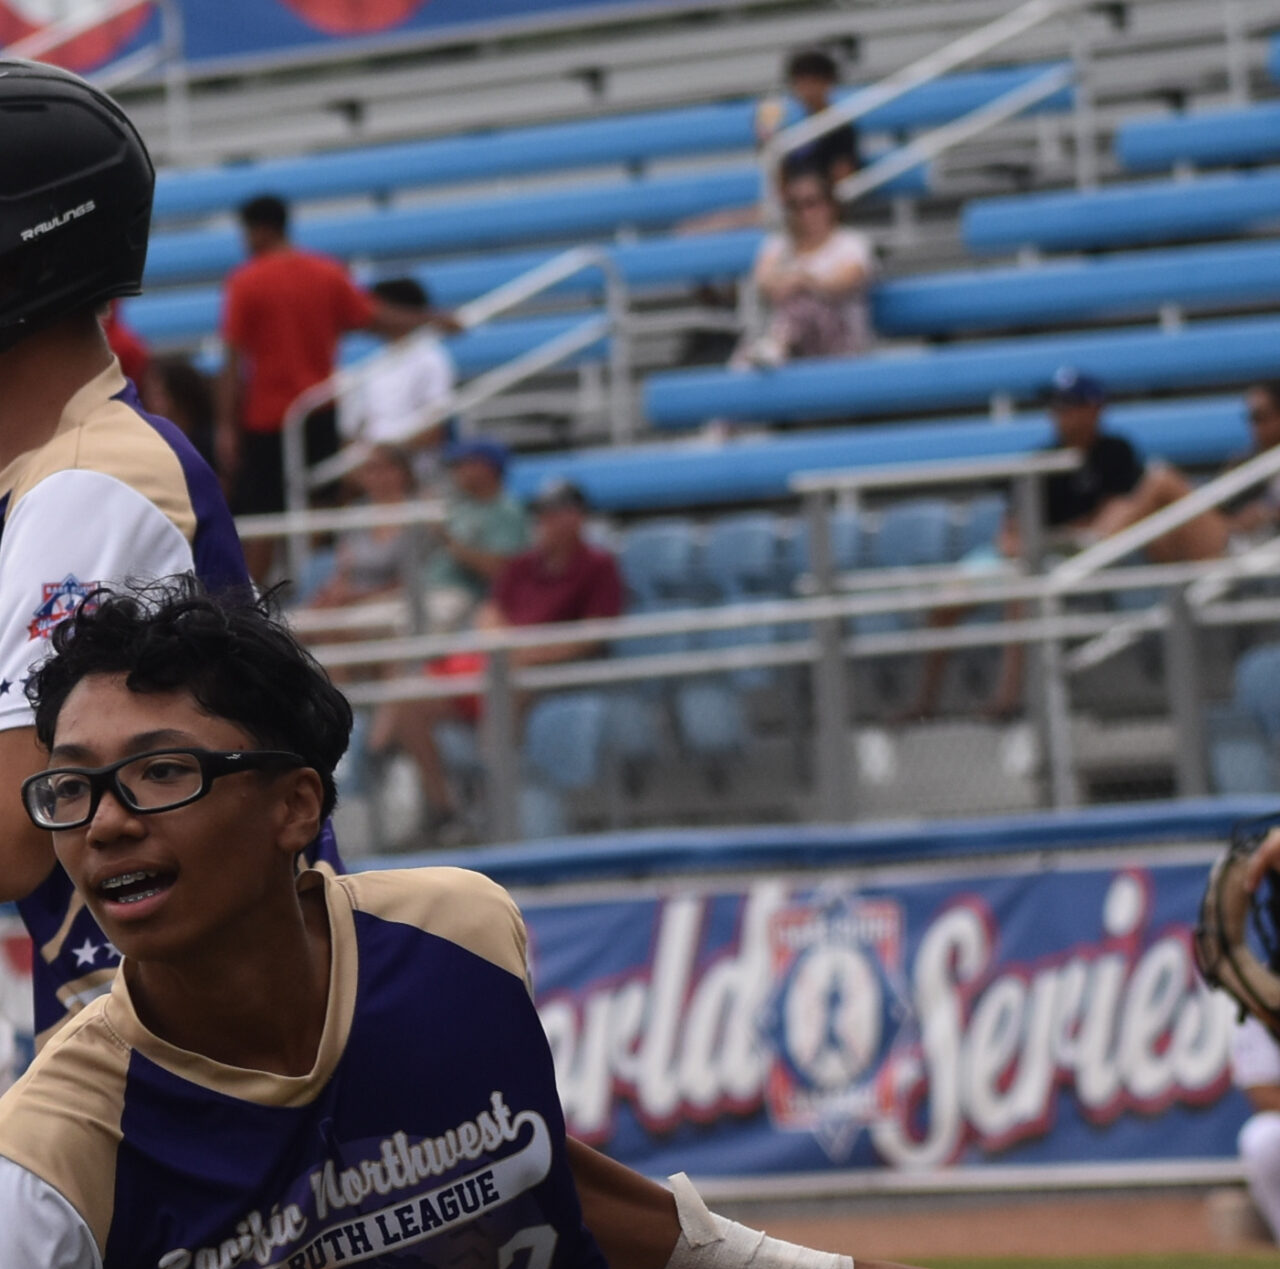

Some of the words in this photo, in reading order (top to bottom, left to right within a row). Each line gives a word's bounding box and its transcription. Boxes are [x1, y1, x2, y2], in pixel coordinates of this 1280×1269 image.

[20, 200, 96, 241] RAWLINGS
[868, 866, 1240, 1170] Series
[310, 1091, 514, 1220] Northwest
[376, 1170, 500, 1247] LEAGUE
